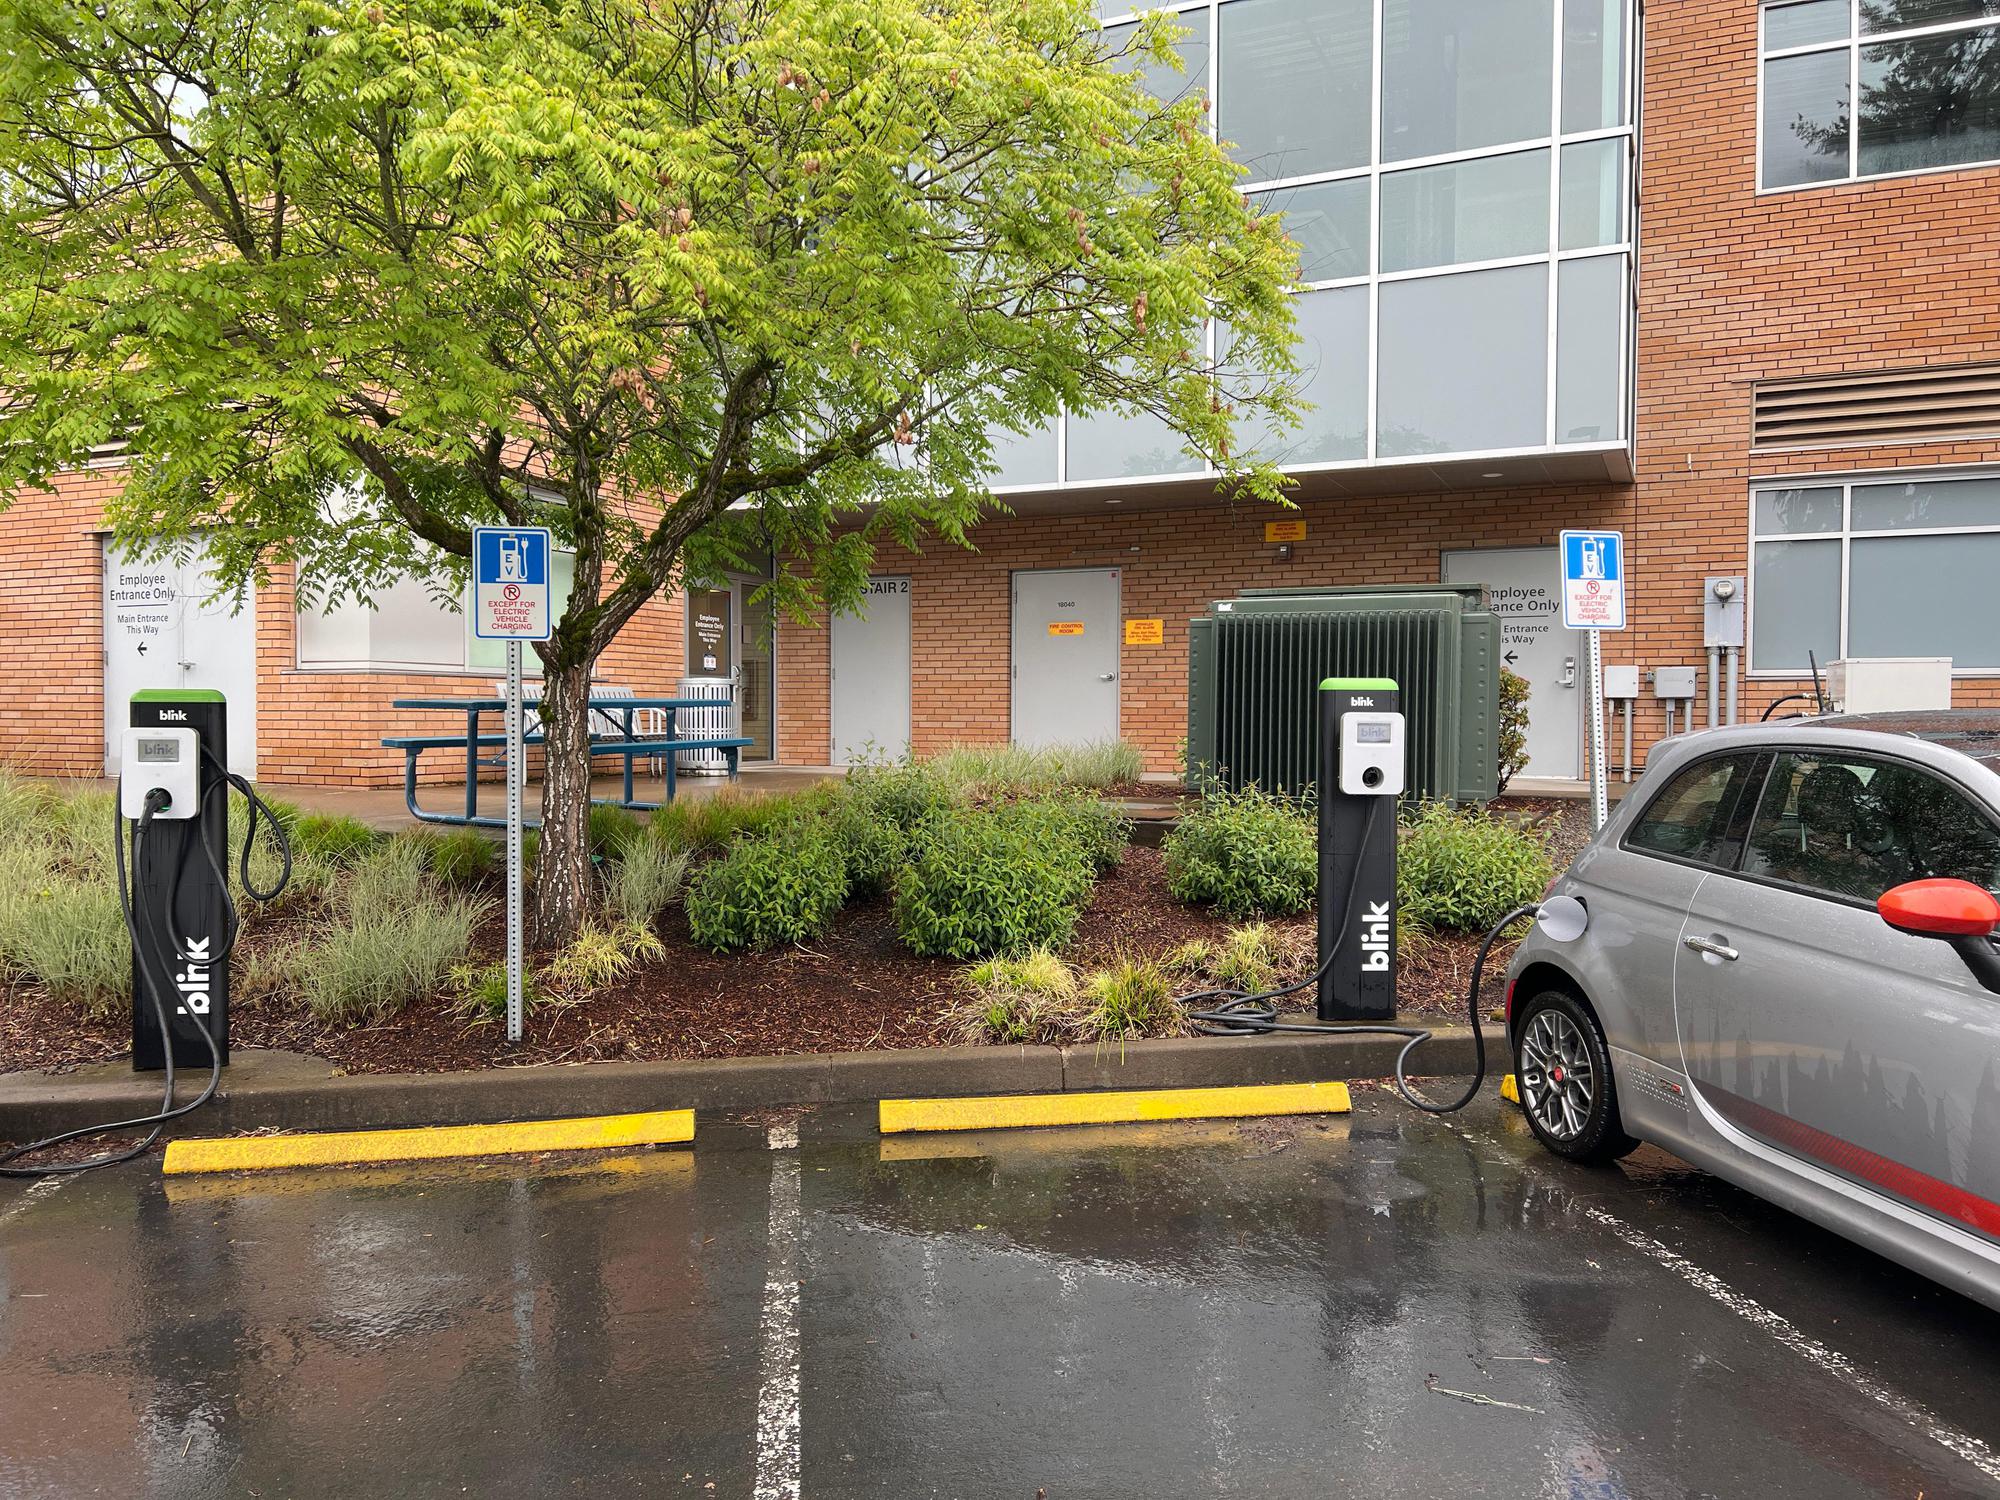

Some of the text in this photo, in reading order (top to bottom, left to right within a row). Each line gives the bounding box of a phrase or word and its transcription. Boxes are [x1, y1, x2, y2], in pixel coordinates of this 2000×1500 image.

[119, 573, 166, 587] Employee
[901, 581, 908, 593] 2
[110, 587, 176, 601] Entrance Only
[1490, 587, 1545, 600] mployee
[488, 600, 518, 608] EXCEPT
[1489, 599, 1560, 613] ance Only
[117, 614, 169, 623] Main Entrance
[126, 625, 159, 635] This Way
[1503, 624, 1549, 633] Entrance
[1512, 635, 1535, 645] Way
[1350, 696, 1374, 707] blink
[159, 710, 188, 721] blink
[1360, 727, 1386, 738] blink
[143, 743, 174, 755] blink
[1361, 901, 1389, 972] blink
[176, 936, 210, 1015] blink
